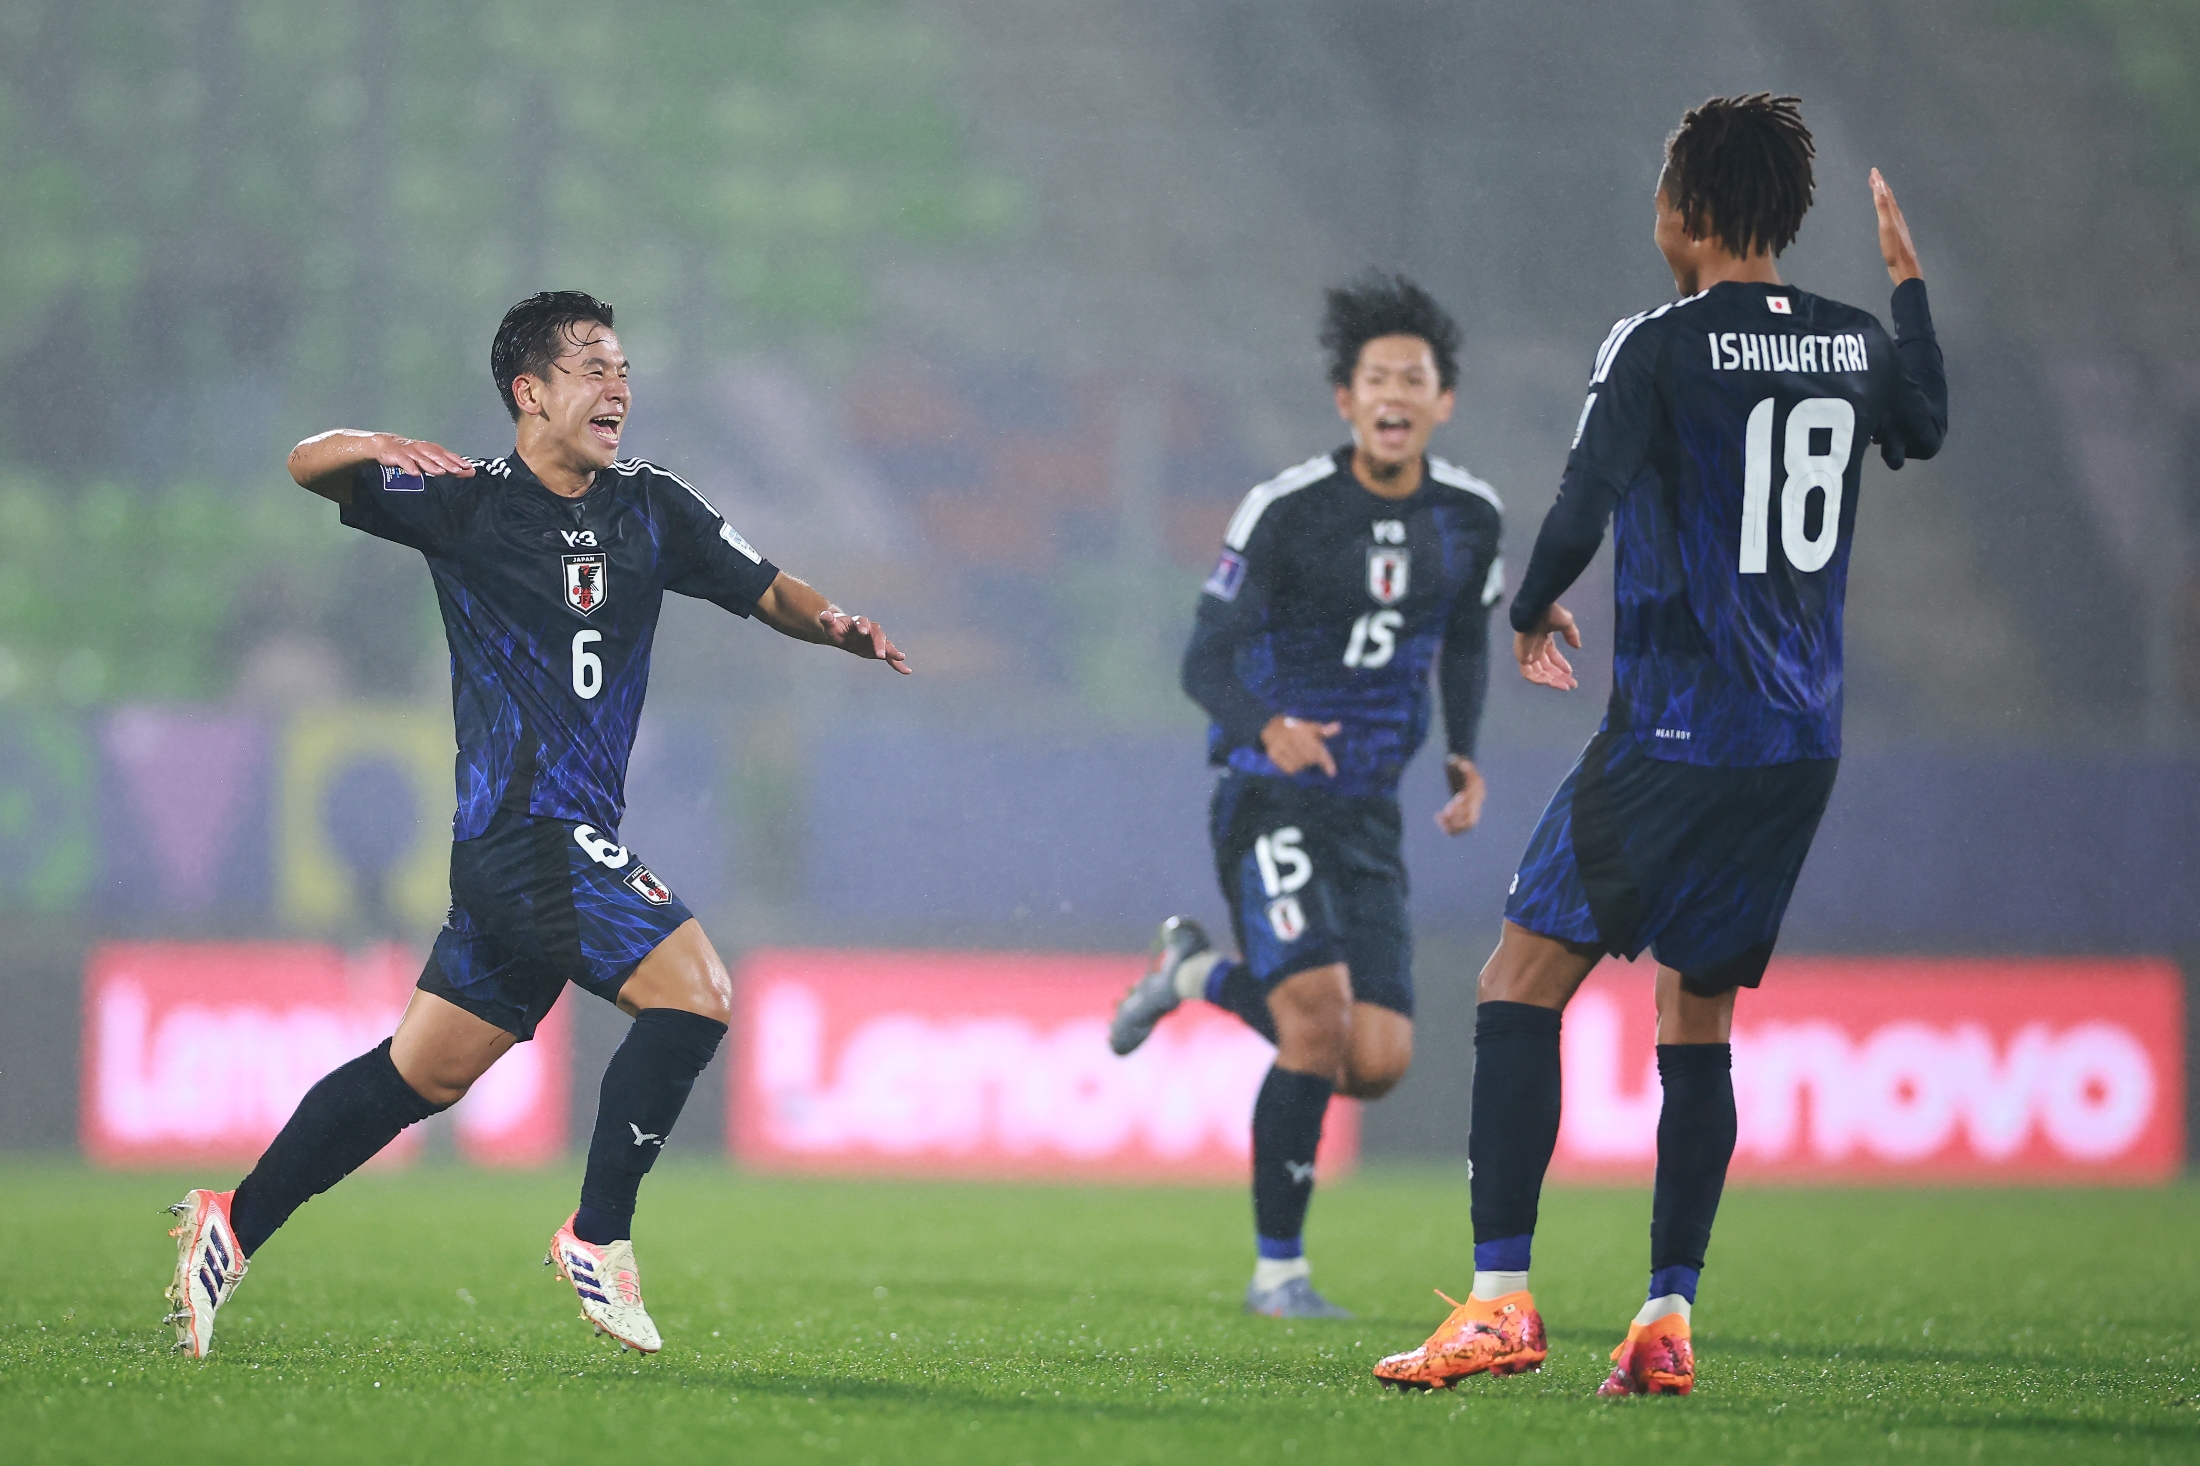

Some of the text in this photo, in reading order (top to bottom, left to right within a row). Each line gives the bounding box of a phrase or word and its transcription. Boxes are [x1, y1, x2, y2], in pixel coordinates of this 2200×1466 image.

[1708, 332, 1869, 373] ISHIWATARI
[1738, 396, 1856, 574] 18
[560, 529, 598, 548] Y-3
[576, 595, 595, 605] JFA
[571, 628, 604, 700] 6
[1342, 608, 1406, 669] 15
[573, 823, 629, 870] 6
[1254, 825, 1313, 897] 15
[1562, 986, 2156, 1162] Lnovo
